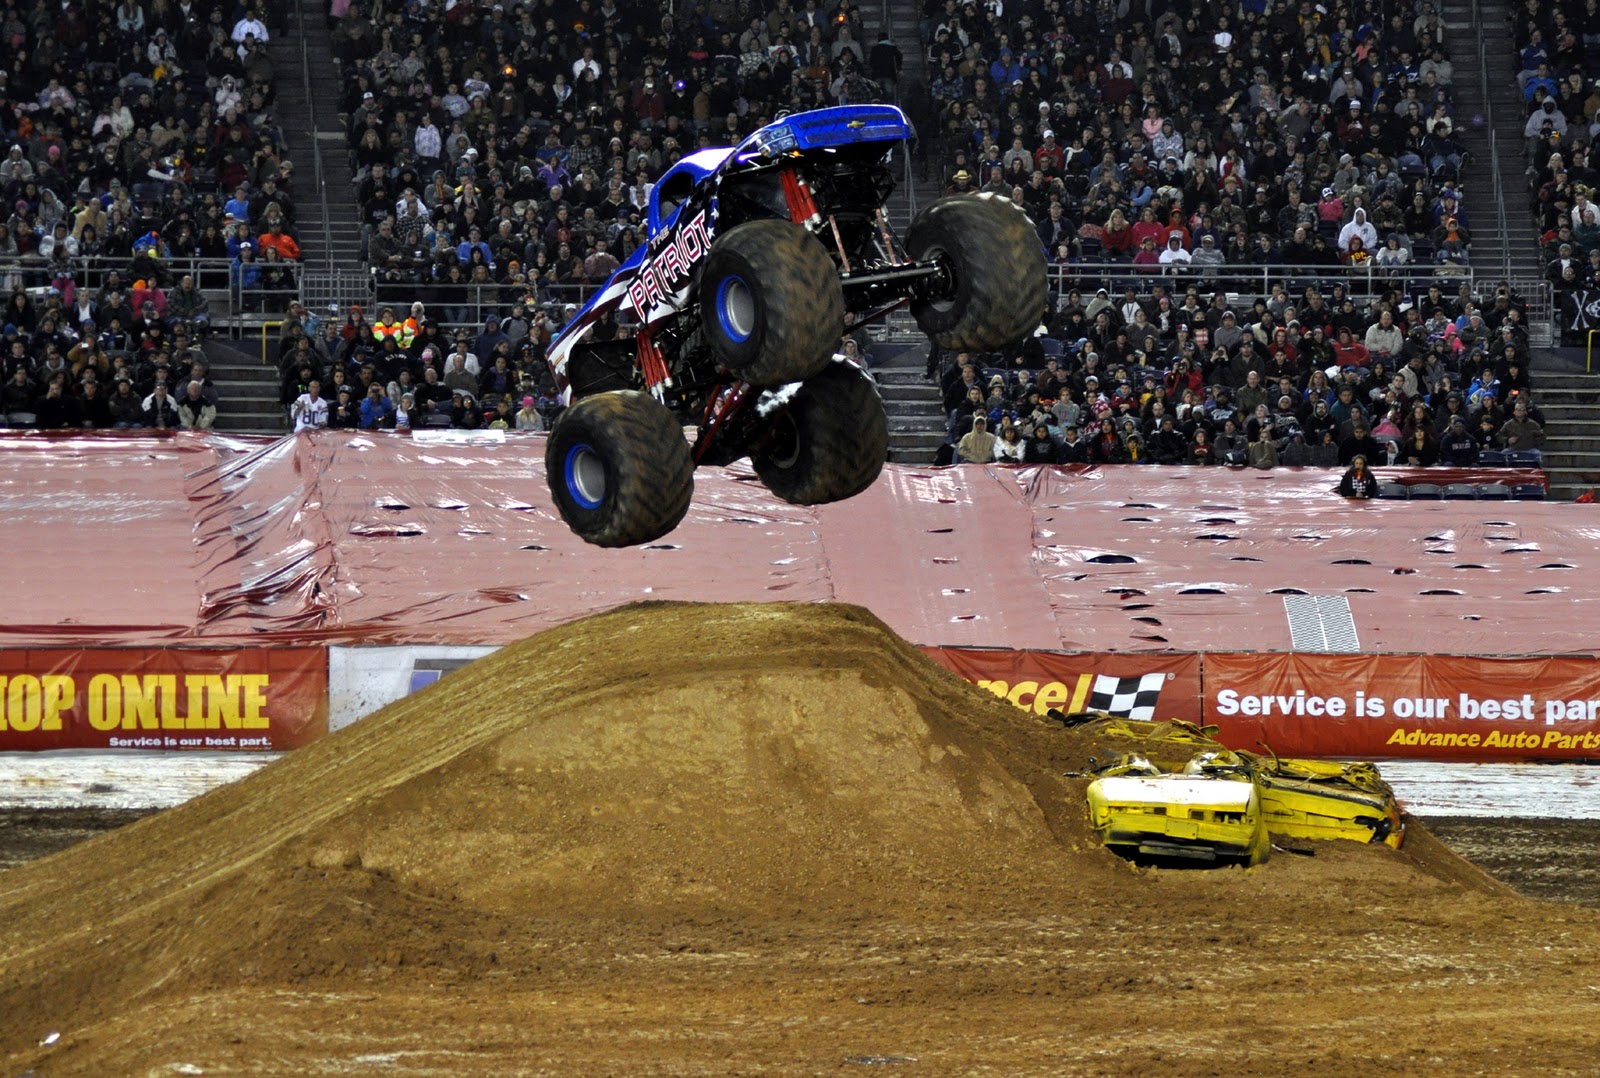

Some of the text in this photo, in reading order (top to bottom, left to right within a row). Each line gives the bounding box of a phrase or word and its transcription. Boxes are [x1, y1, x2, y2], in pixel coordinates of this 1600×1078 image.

[628, 208, 712, 325] PATRIOT
[0, 674, 270, 731] OP ONLINE
[1216, 689, 1347, 717] Service
[1355, 690, 1386, 717] is
[1393, 697, 1450, 718] our
[1459, 693, 1535, 720] best
[109, 737, 161, 747] Service
[164, 736, 177, 746] is
[179, 737, 202, 746] our
[205, 736, 236, 746] best
[1386, 728, 1600, 749] Advance Auto Parts
